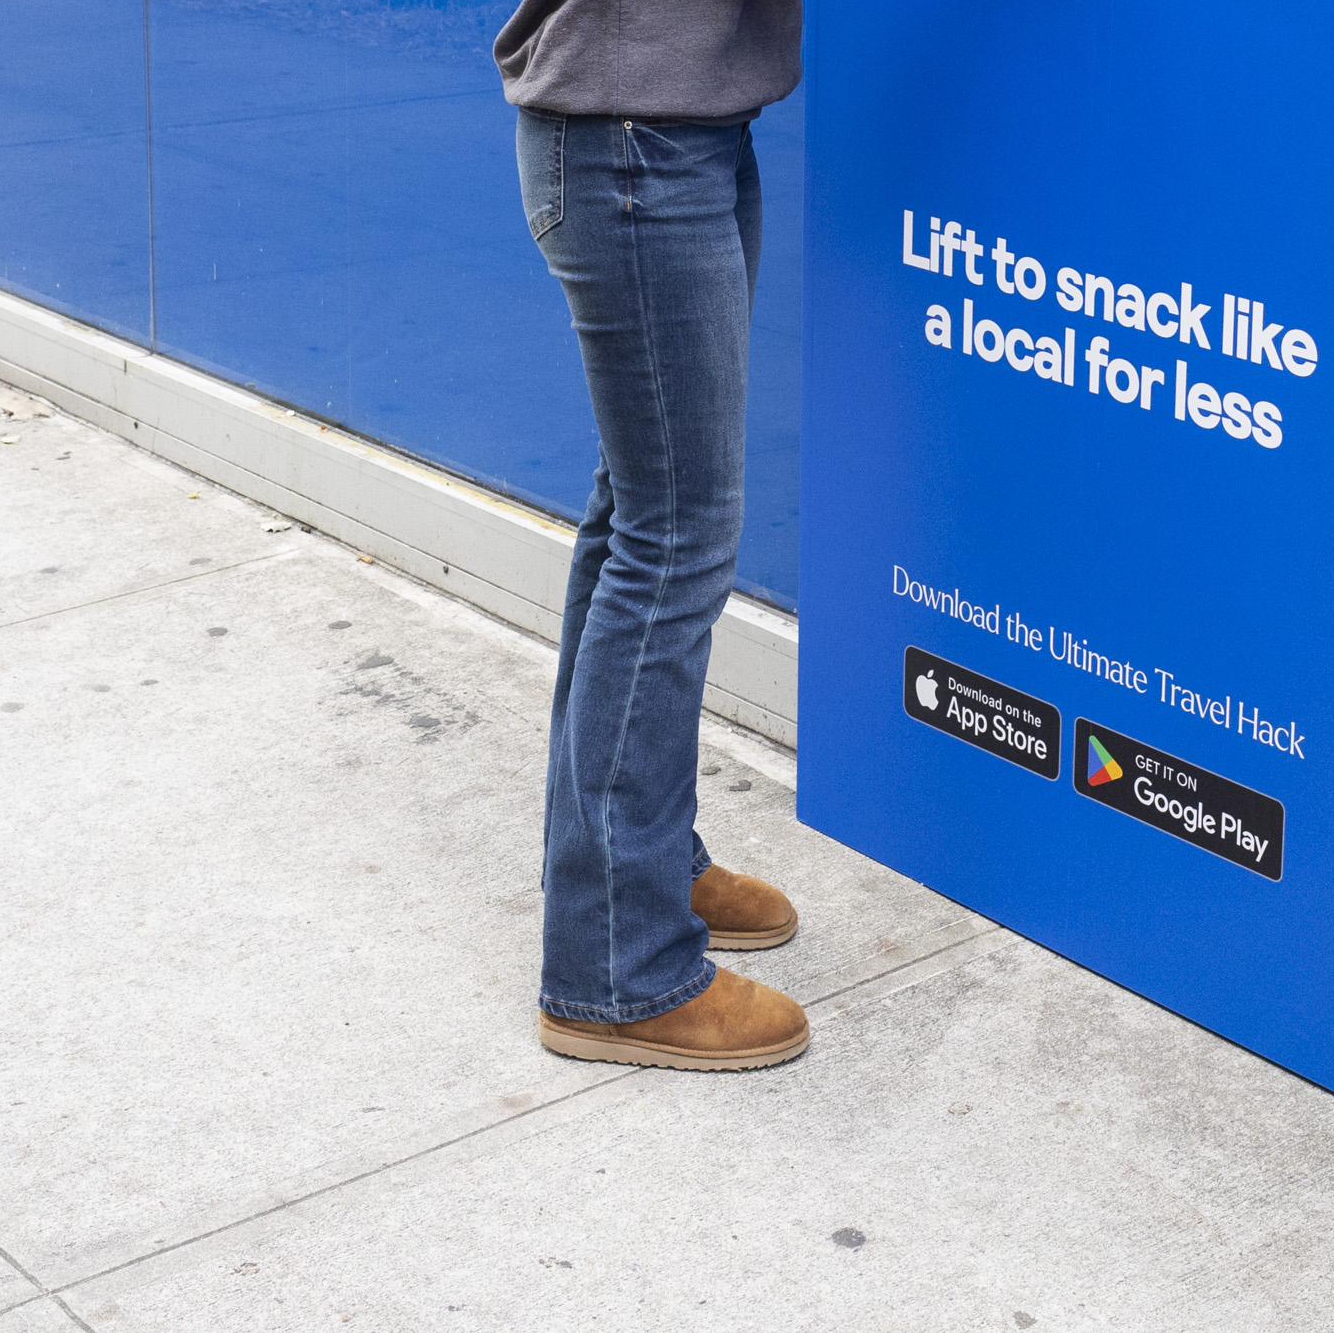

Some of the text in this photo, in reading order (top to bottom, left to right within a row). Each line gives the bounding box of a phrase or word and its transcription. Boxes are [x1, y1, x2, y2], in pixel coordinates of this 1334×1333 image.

[903, 210, 1318, 377] Lift to snack like
[925, 299, 1283, 449] a local for less
[893, 565, 1306, 759] Download the Ultimate Travel Hack
[948, 676, 1042, 728] Download on the
[947, 696, 1047, 760] App Store
[1135, 754, 1197, 792] GET IT ON
[1134, 777, 1269, 862] Google Play
